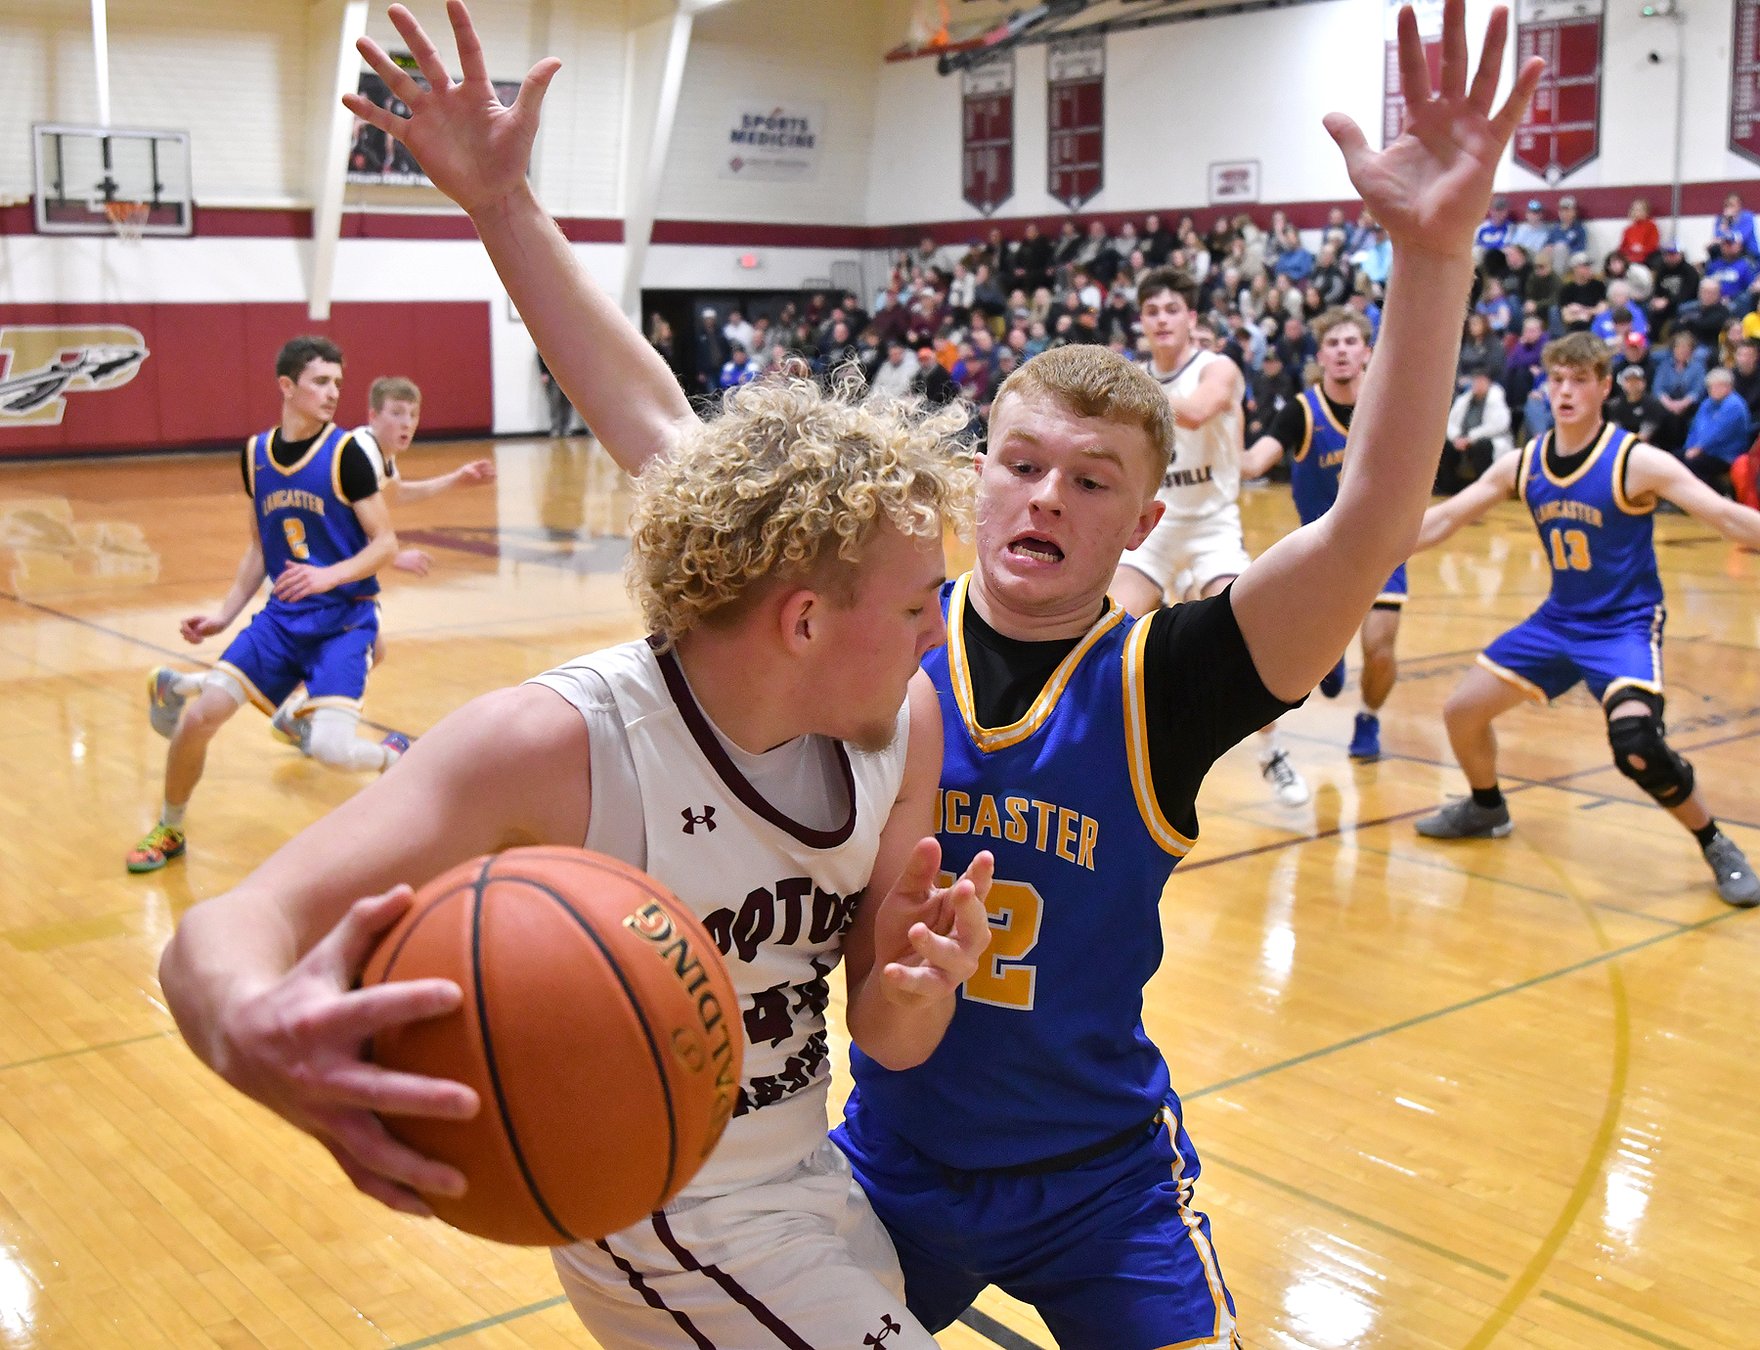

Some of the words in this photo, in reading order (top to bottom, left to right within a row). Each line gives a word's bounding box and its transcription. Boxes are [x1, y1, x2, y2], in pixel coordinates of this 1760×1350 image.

[742, 112, 808, 131] SPORTS
[730, 129, 815, 149] MEDICINE
[262, 488, 325, 516] LANCASTER
[1533, 499, 1604, 529] LANCASTER
[283, 517, 311, 560] 2
[1550, 528, 1592, 571] 13
[934, 788, 1099, 871] CASTER
